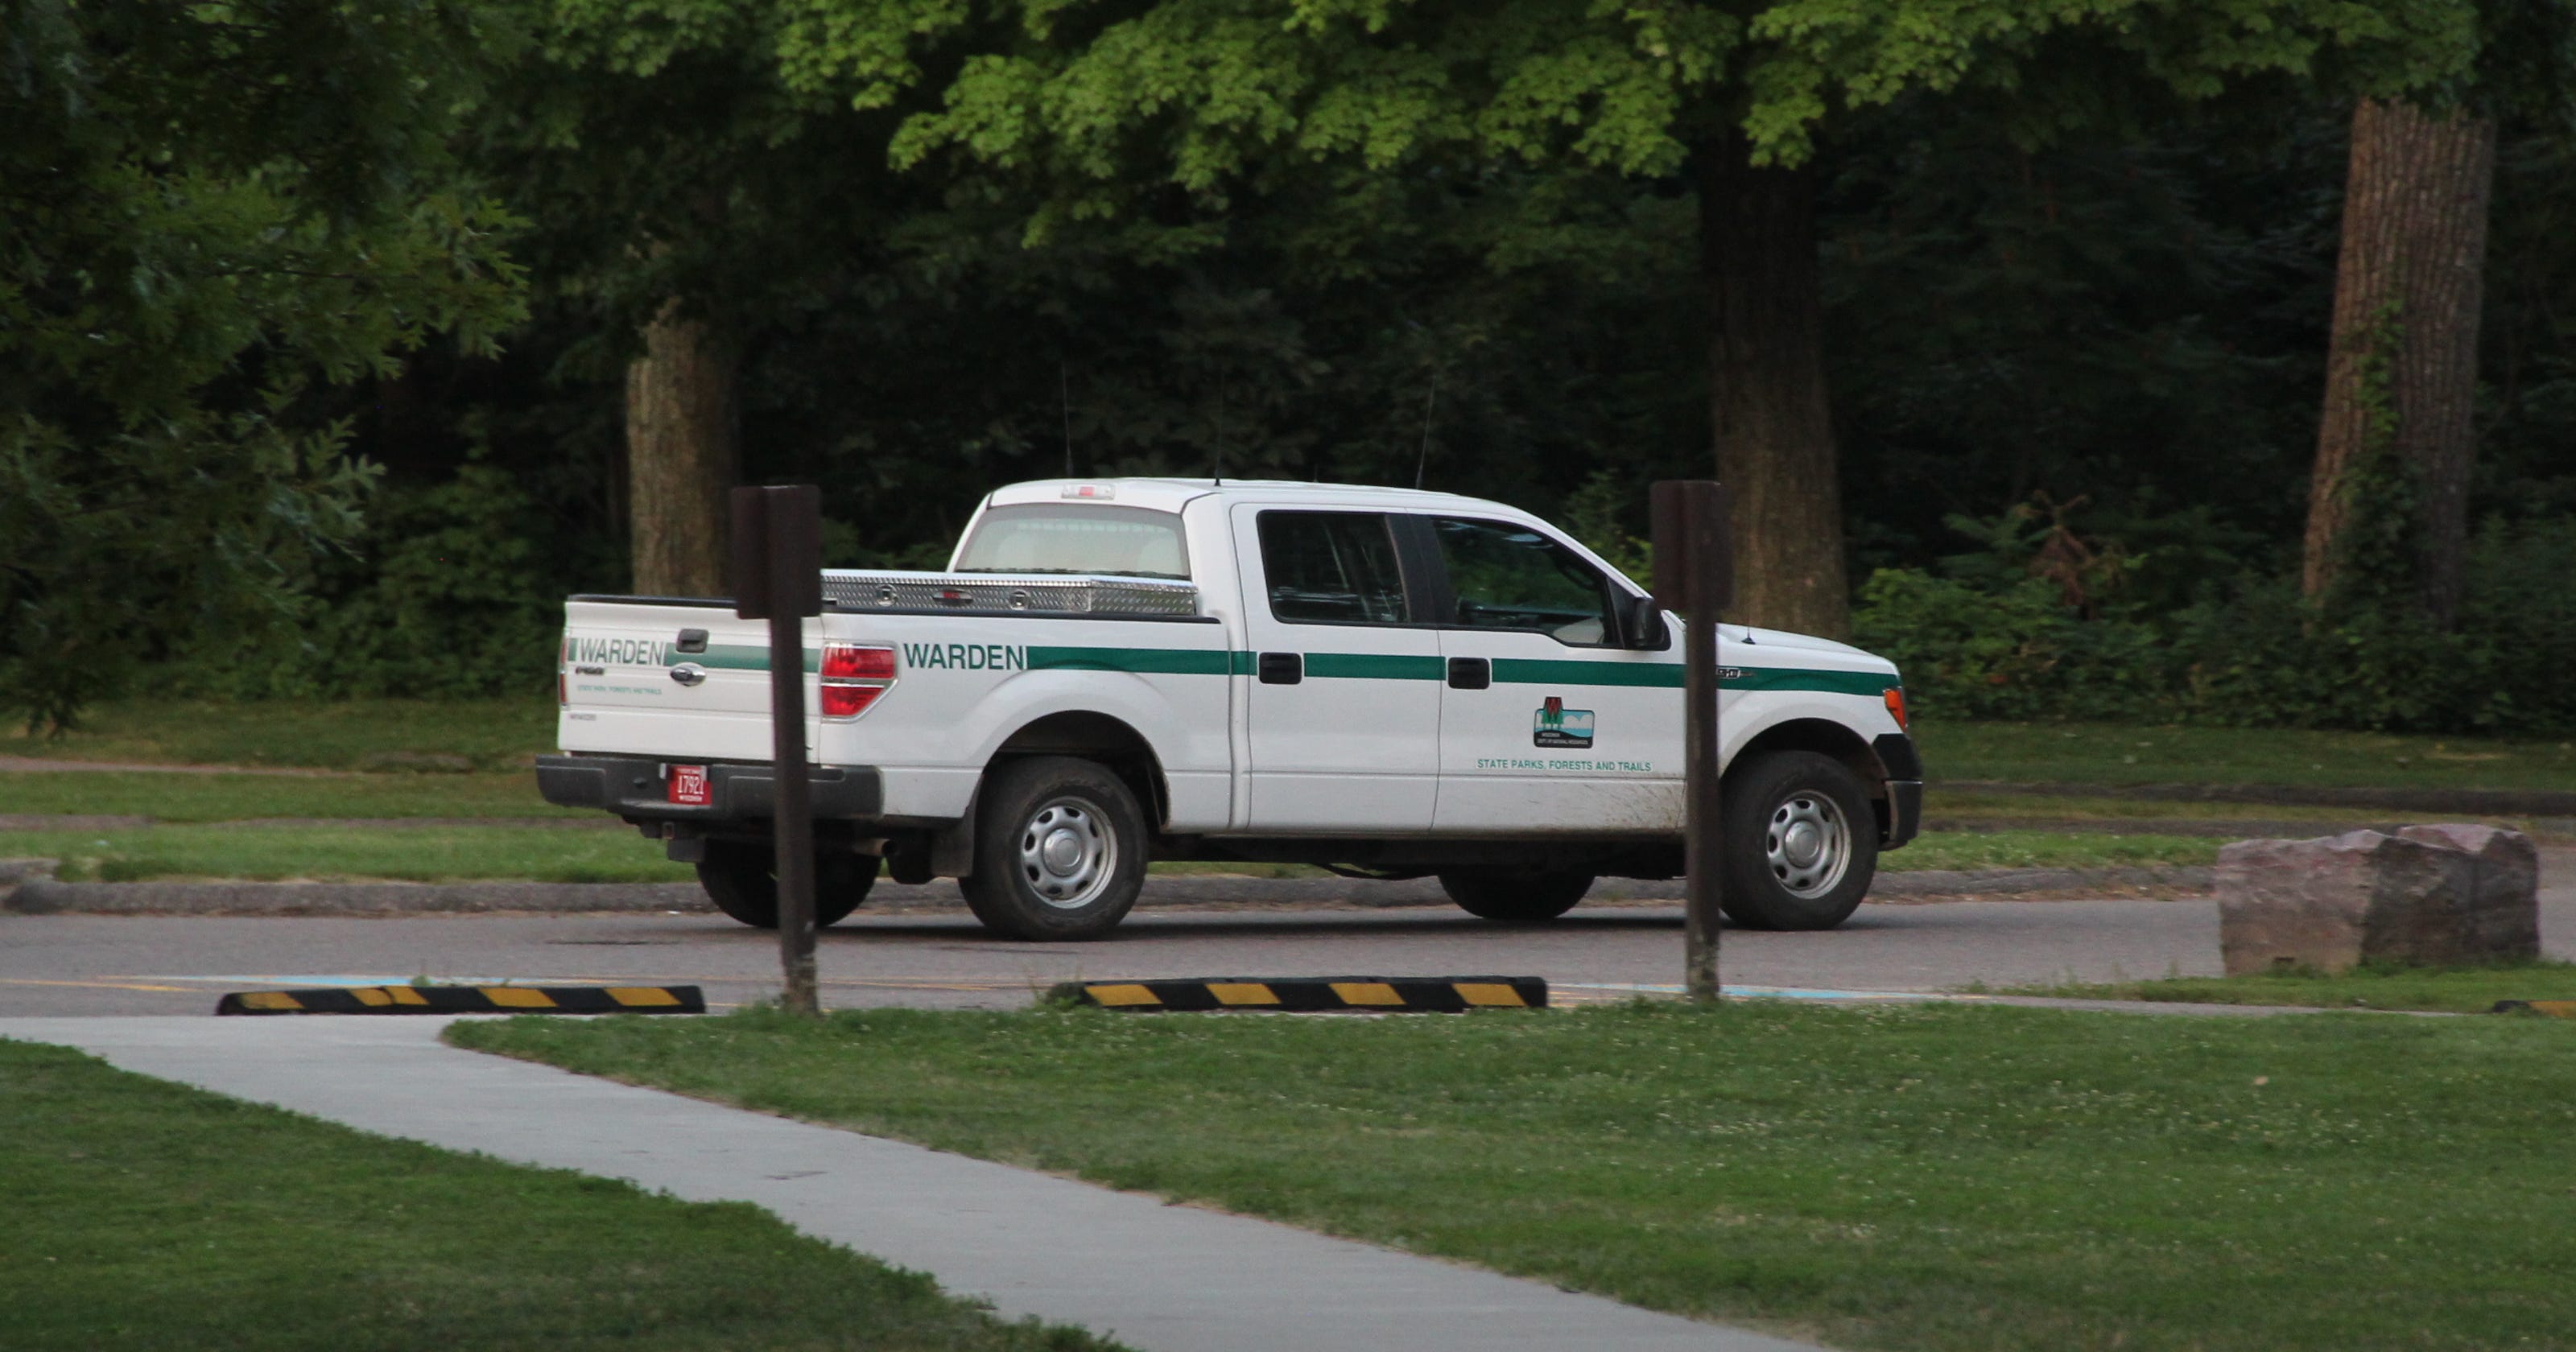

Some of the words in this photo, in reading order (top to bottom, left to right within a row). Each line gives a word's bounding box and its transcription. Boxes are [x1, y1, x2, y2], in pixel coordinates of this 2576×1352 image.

[580, 637, 663, 665] WARDEN
[903, 643, 1024, 670] WARDEN
[1476, 759, 1508, 769] STATE
[1549, 760, 1592, 770] FORESTS
[1596, 761, 1615, 771] AND
[1618, 761, 1652, 772] TRAILS
[678, 774, 704, 794] 17921
